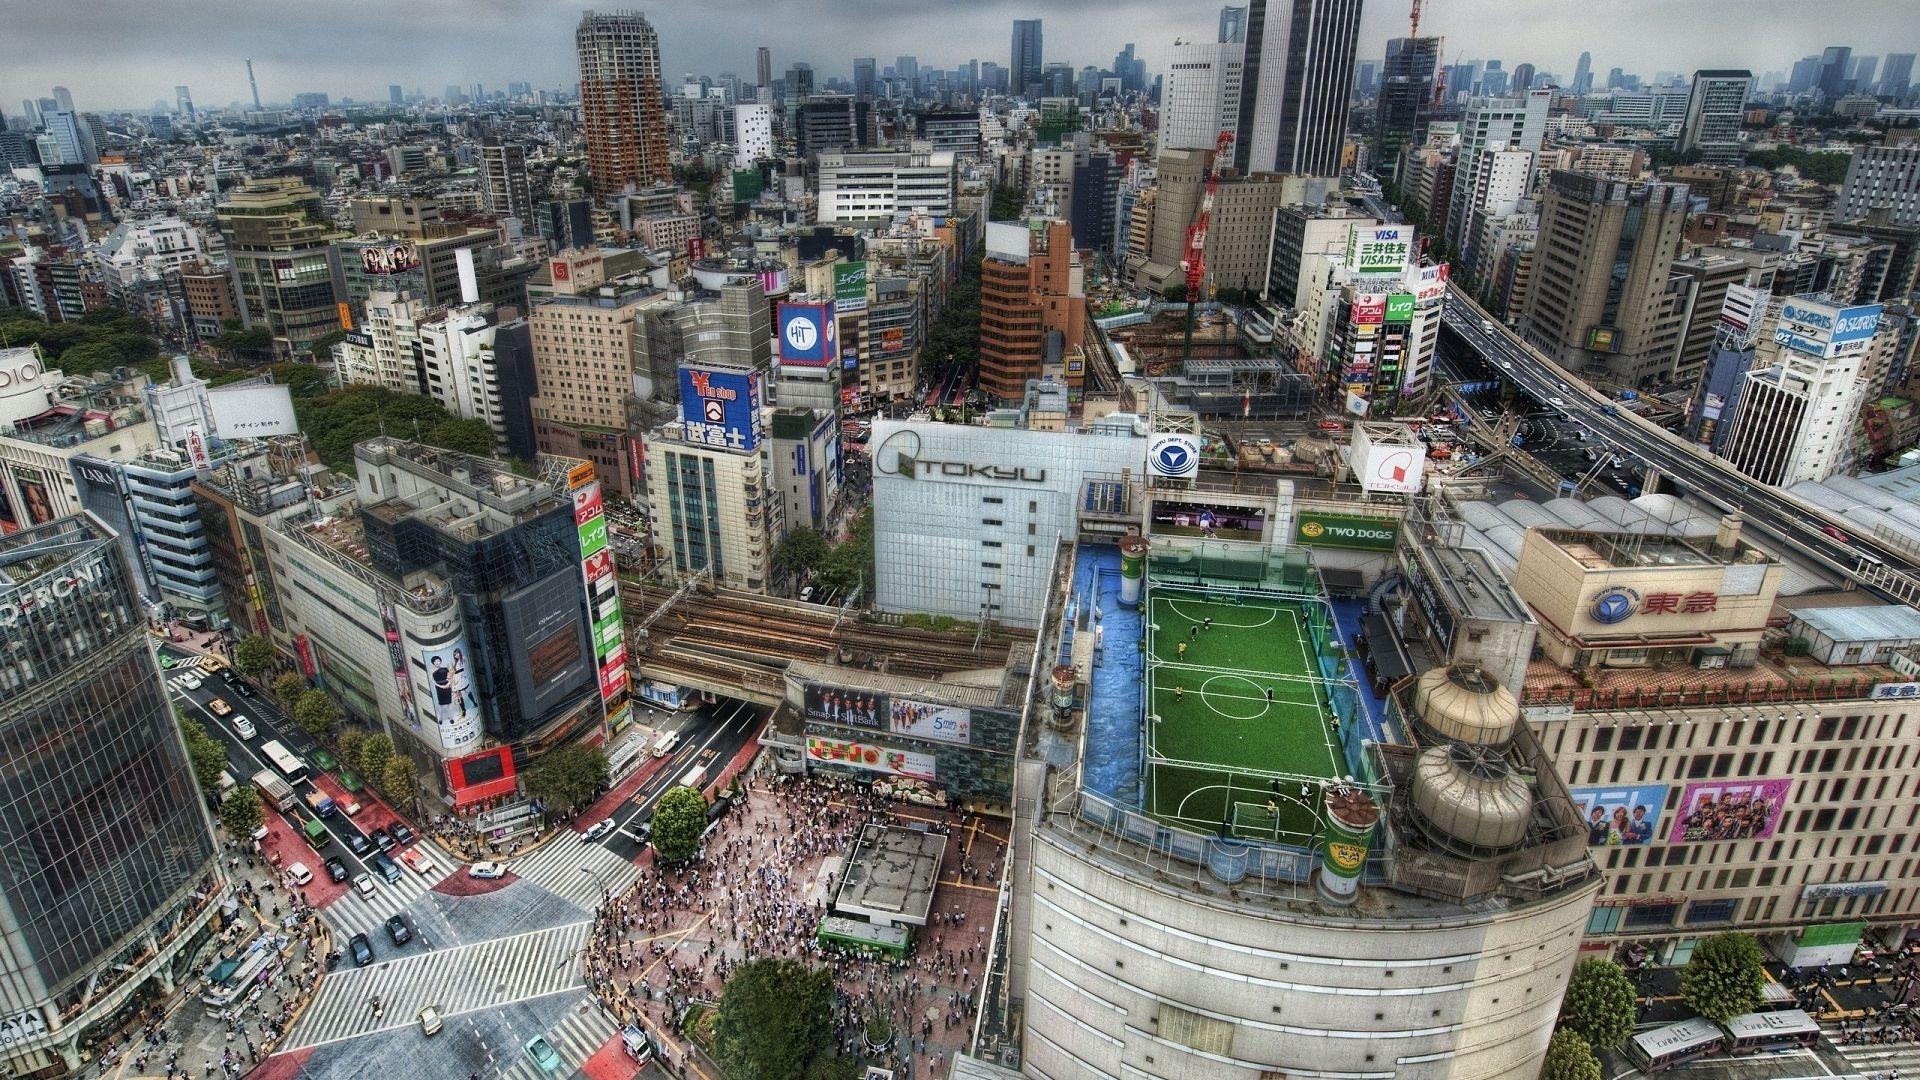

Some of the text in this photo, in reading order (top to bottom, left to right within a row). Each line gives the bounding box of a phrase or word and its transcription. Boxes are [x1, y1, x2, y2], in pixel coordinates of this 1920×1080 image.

[1376, 230, 1399, 240] VISA
[1361, 243, 1407, 254] 三井住友
[1360, 255, 1406, 265] VISAカード
[1361, 307, 1382, 315] アコム
[1389, 302, 1413, 312] レイク
[1795, 309, 1831, 329] STARTS
[1845, 314, 1879, 332] STARTS
[1790, 323, 1818, 336] スターツ
[716, 386, 737, 401] shop
[686, 420, 746, 449] 武富士
[190, 429, 205, 462] 大和証券
[1151, 439, 1166, 452] TOKYU
[1184, 440, 1198, 454] STORE
[76, 465, 116, 485] ZARA
[917, 460, 1046, 483] TOKYU
[1367, 482, 1417, 491] TOKYU
[579, 504, 604, 522] アコム
[581, 525, 605, 547] レイク
[1324, 526, 1394, 540] TWO DOGS
[588, 563, 610, 581] アイフル
[1640, 591, 1719, 616] 東急
[1877, 685, 1918, 698] 東急
[807, 707, 831, 720] Smap
